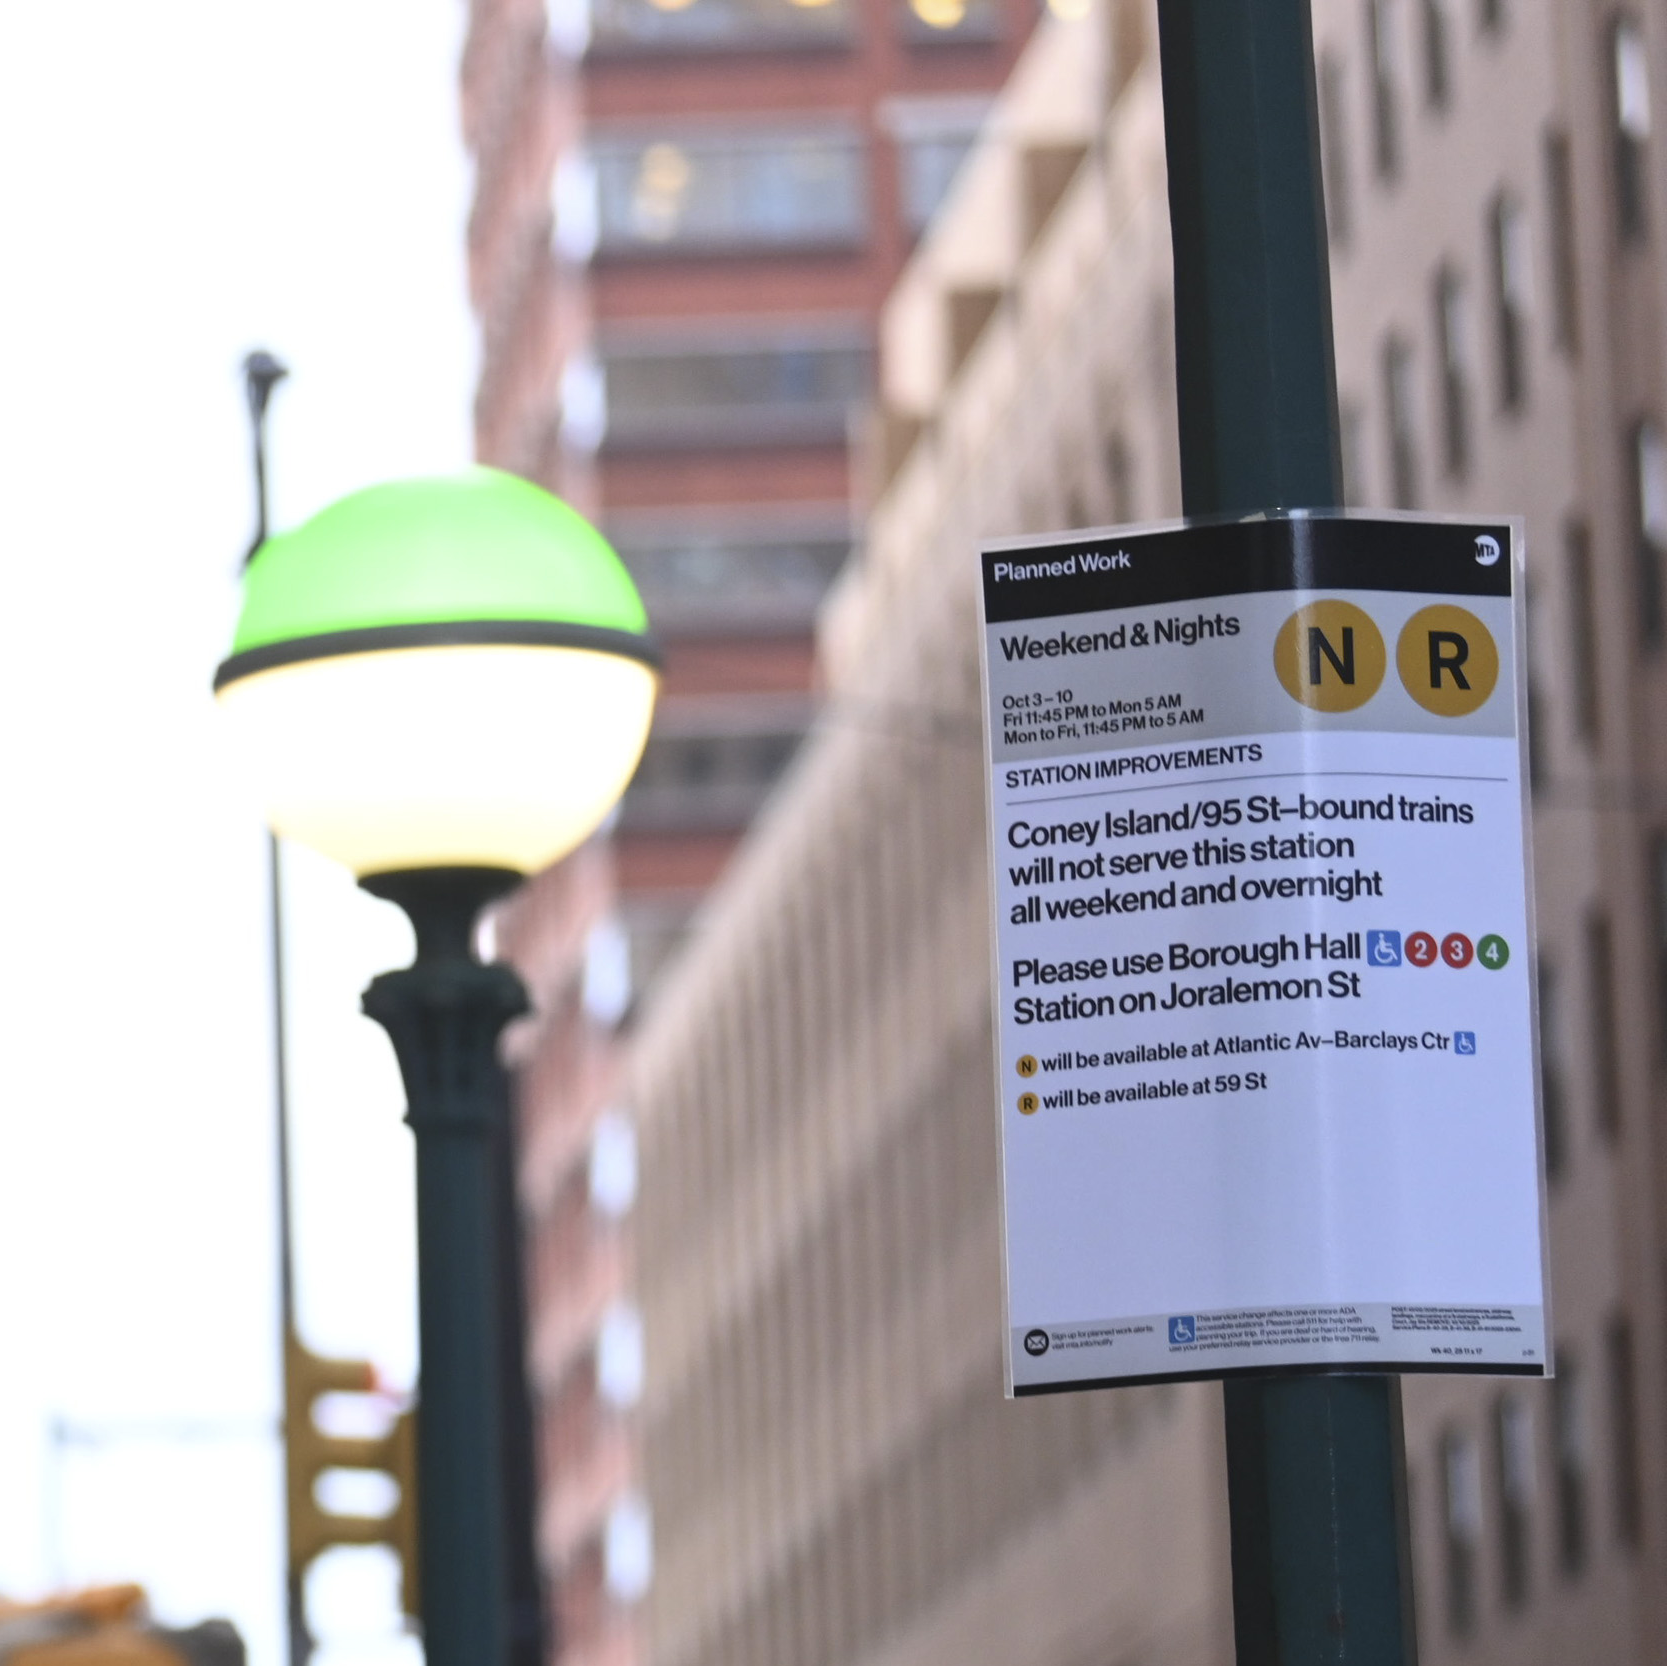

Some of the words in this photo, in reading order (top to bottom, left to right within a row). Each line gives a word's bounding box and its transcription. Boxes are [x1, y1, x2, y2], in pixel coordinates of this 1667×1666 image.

[993, 555, 1076, 582] Planned
[1079, 550, 1131, 574] Work
[1000, 625, 1127, 662] Weekend
[1130, 622, 1149, 647] &
[1154, 613, 1240, 646] Nights
[1308, 627, 1355, 685] N
[1428, 630, 1471, 691] R
[1002, 695, 1030, 710] Oct
[1003, 711, 1023, 727] Fri
[1025, 708, 1062, 725] 11:45
[1065, 705, 1088, 720] PM
[1092, 704, 1106, 717] to
[1108, 699, 1142, 716] Mon
[1144, 697, 1155, 711] 5
[1157, 693, 1182, 709] AM
[1004, 730, 1037, 745] Mon
[1040, 727, 1055, 741] to
[1057, 723, 1080, 741] Fri,
[1082, 720, 1119, 736] 11:45
[1122, 717, 1146, 732] PM
[1149, 715, 1164, 728] to
[1166, 712, 1176, 726] 5
[1179, 709, 1204, 725] AM
[1005, 762, 1092, 789] STATION
[1094, 743, 1263, 779] IMPROVEMENTS
[1007, 819, 1100, 849] Coney
[1105, 798, 1242, 839] Island/95
[1398, 795, 1474, 824] trains
[1008, 856, 1054, 887] will
[1059, 852, 1105, 881] not
[1109, 848, 1188, 876] serve
[1192, 837, 1246, 867] this
[1250, 831, 1355, 861] station
[1010, 896, 1041, 925] all
[1045, 881, 1176, 921] weekend
[1180, 874, 1236, 906] and
[1241, 869, 1383, 902] overnight
[1013, 958, 1108, 987] Please
[1112, 951, 1164, 976] use
[1169, 933, 1298, 971] Borough
[1305, 932, 1361, 961] Hall
[1415, 940, 1428, 960] 2
[1450, 940, 1464, 960] 3
[1485, 942, 1499, 962] 4
[1014, 992, 1114, 1025] Station
[1119, 991, 1156, 1014] on
[1161, 977, 1322, 1011] Joralemon
[1327, 970, 1361, 998] St
[1041, 1052, 1072, 1072] will
[1076, 1052, 1100, 1069] be
[1103, 1042, 1188, 1067] available
[1191, 1040, 1210, 1058] at
[1213, 1033, 1291, 1055] Atlantic
[1421, 1031, 1450, 1050] Ctr
[1042, 1090, 1073, 1110] will
[1077, 1089, 1101, 1106] be
[1104, 1079, 1189, 1103] available
[1192, 1077, 1211, 1095] at
[1214, 1074, 1241, 1093] 59
[1244, 1072, 1267, 1090] St
